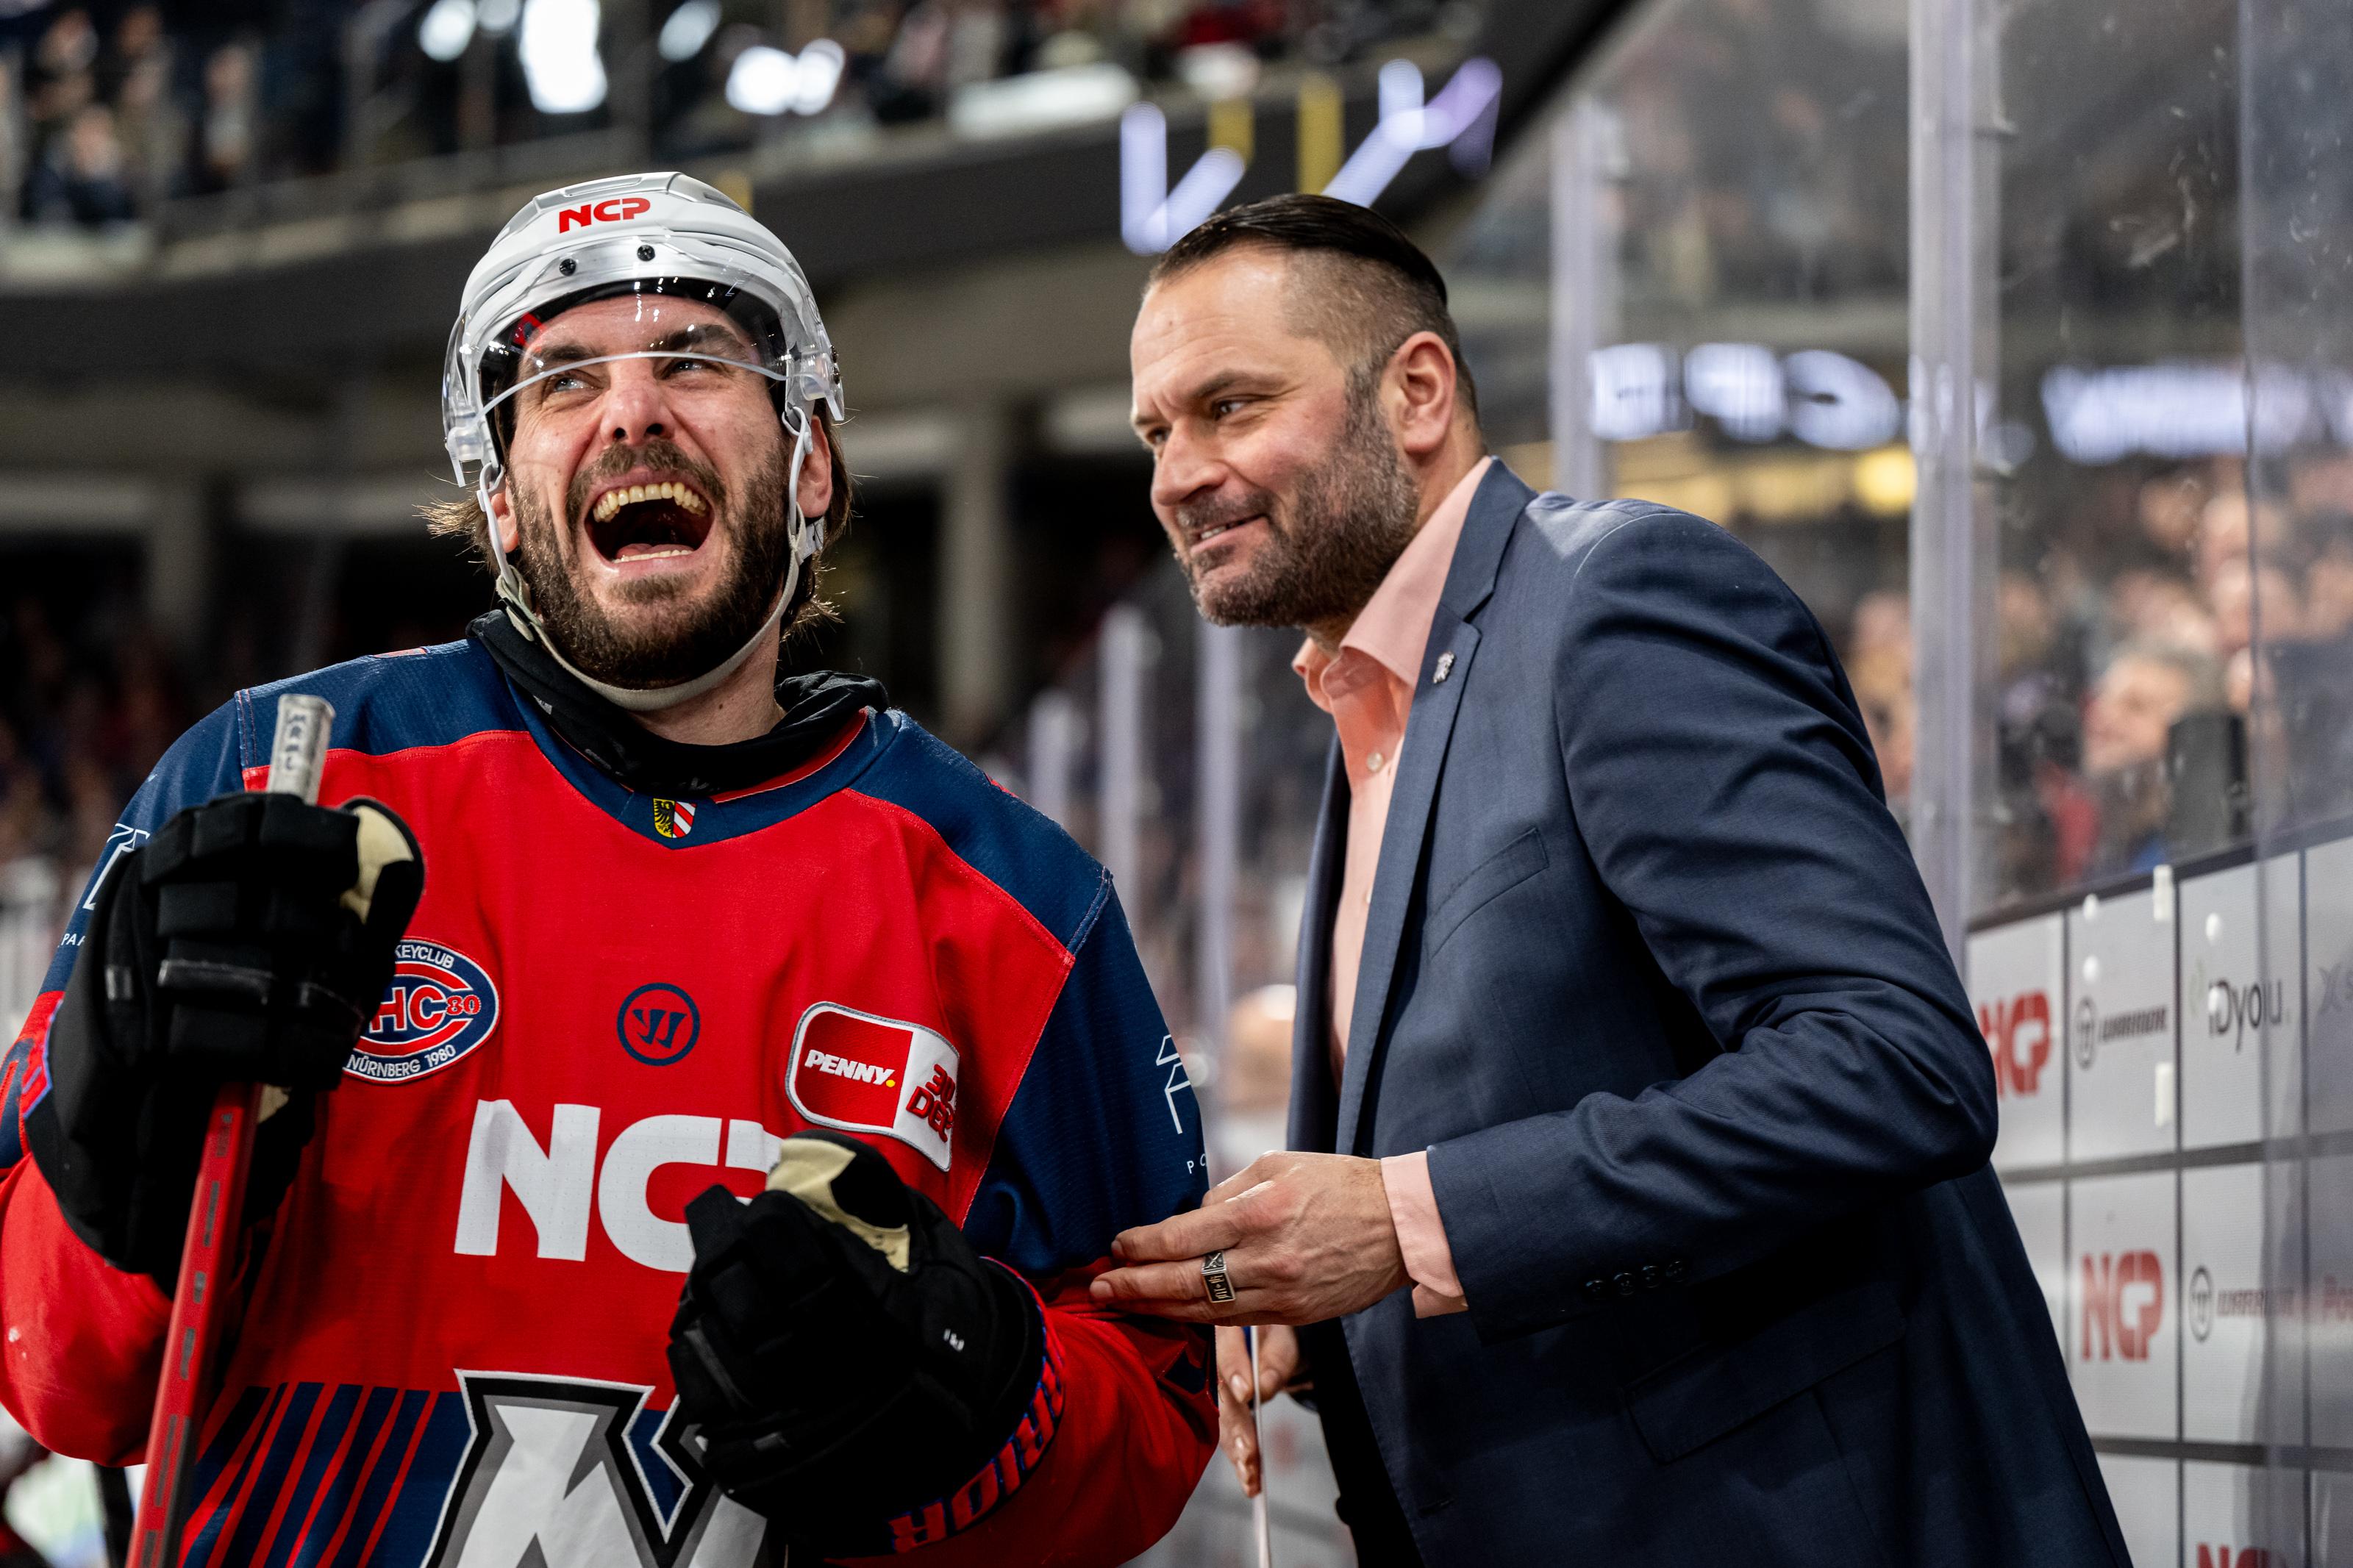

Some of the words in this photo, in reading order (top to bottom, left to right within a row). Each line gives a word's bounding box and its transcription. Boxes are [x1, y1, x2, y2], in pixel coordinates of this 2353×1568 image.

[559, 197, 651, 234] NCP
[395, 945, 454, 969] KEYCLUB
[369, 984, 446, 1033] HC
[346, 1054, 421, 1078] NÜRNBERG
[424, 1044, 456, 1067] 1980
[2080, 1249, 2164, 1362] NCP
